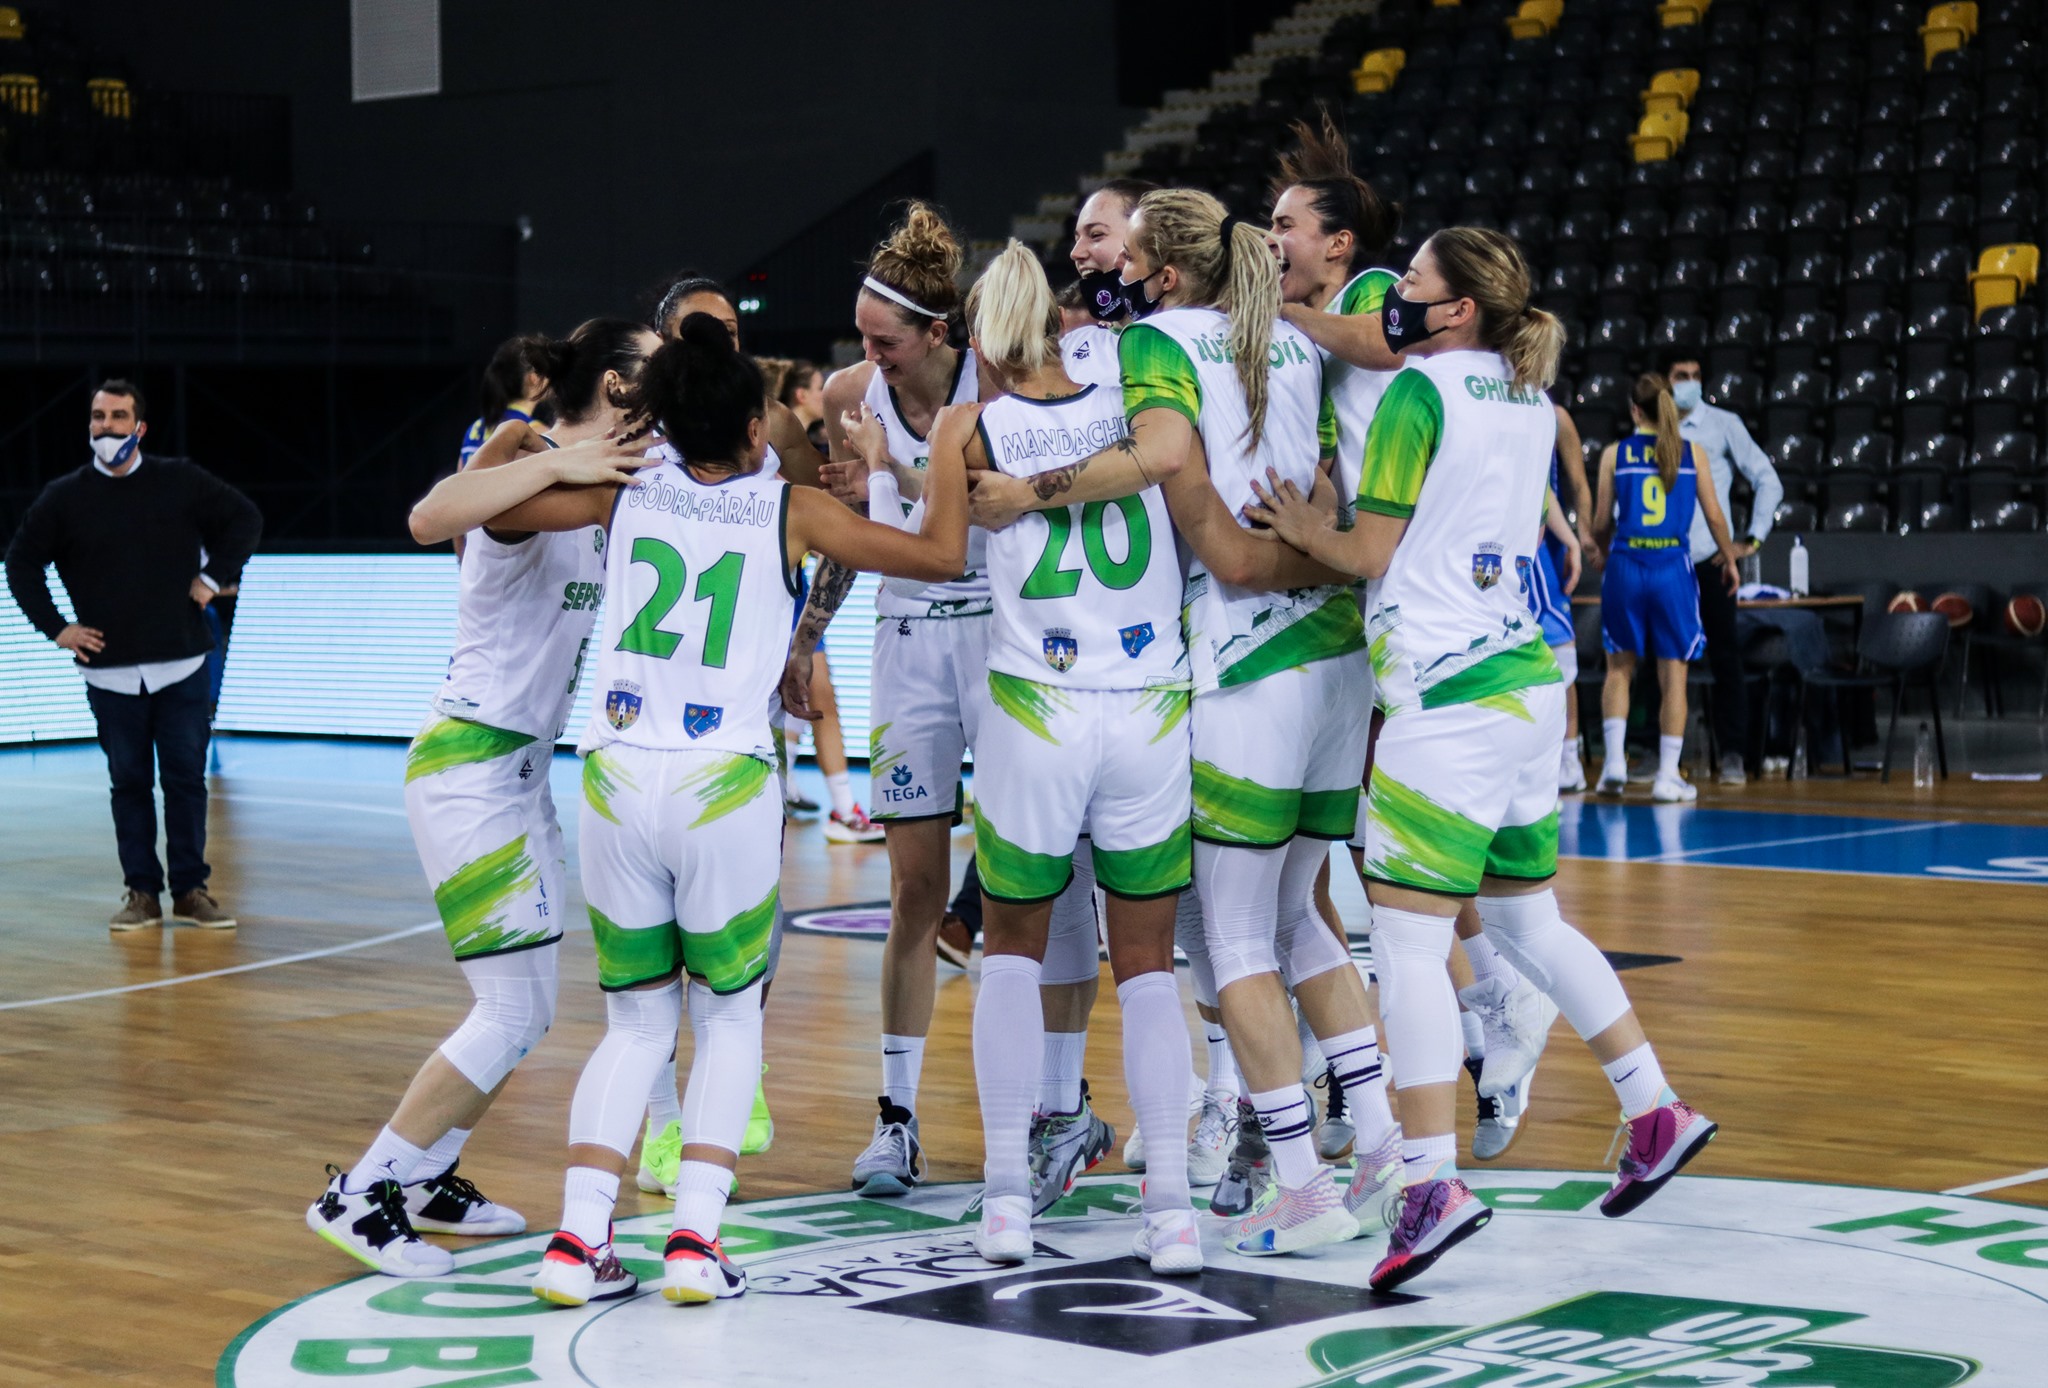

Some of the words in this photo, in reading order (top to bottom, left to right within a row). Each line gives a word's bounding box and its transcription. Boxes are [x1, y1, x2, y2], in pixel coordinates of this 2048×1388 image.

[1642, 475, 1667, 527] 9
[1019, 492, 1152, 600] 20
[614, 537, 746, 669] 21
[883, 785, 928, 803] TEGA
[750, 1240, 1076, 1297] AQUA
